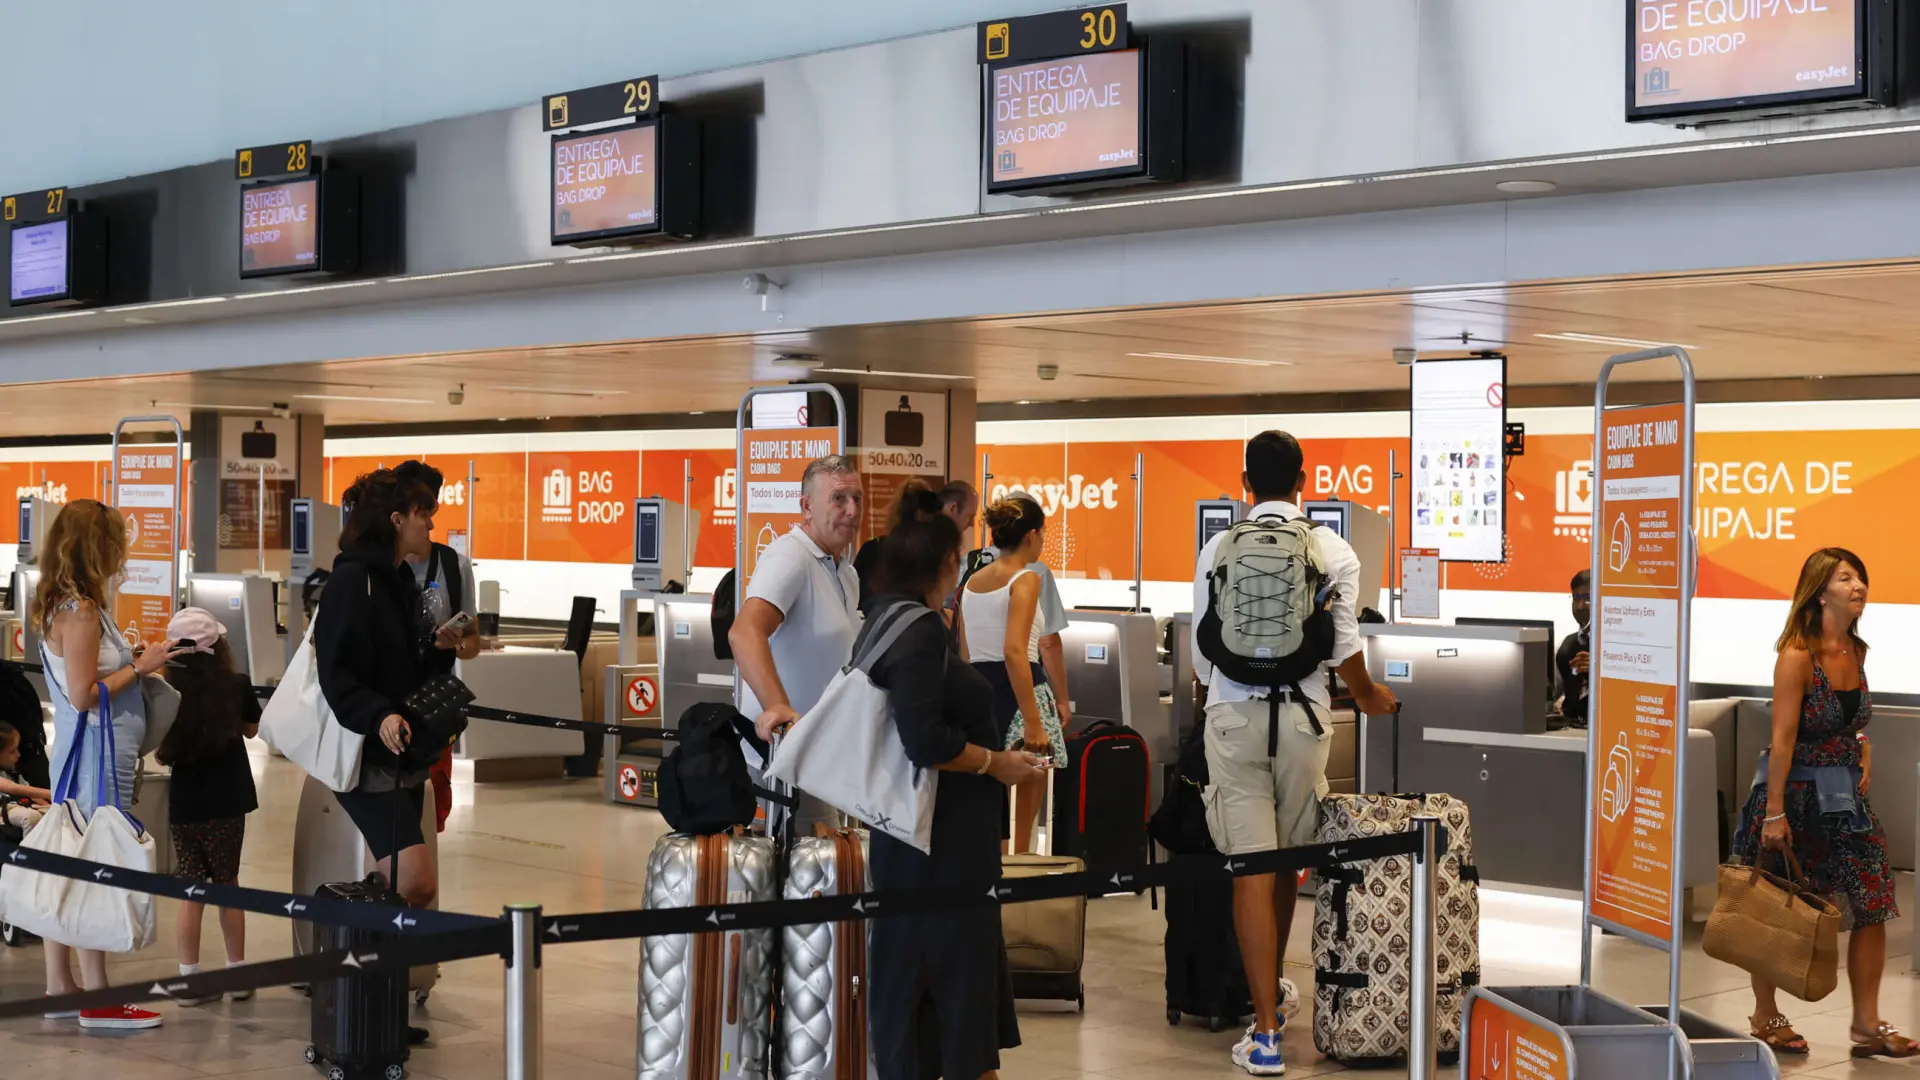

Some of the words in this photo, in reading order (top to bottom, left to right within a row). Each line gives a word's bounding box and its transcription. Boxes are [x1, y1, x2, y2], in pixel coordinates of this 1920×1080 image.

[1080, 9, 1116, 48] 30
[1641, 4, 1678, 32] DE
[1640, 40, 1682, 62] BAG
[1688, 32, 1746, 57] DROP
[996, 64, 1088, 98] ENTREGA
[1796, 65, 1848, 82] easyJet
[624, 80, 650, 114] 29
[997, 98, 1022, 122] DE
[1028, 83, 1120, 118] EQUIPAJE
[996, 127, 1024, 146] BAG
[1028, 122, 1066, 141] DROP
[287, 144, 306, 172] 28
[557, 138, 620, 165] ENTREGA
[1098, 148, 1134, 162] easyJet
[557, 166, 574, 185] DE
[578, 154, 644, 182] EQUIPAJE
[47, 189, 64, 214] 27
[244, 189, 292, 212] ENTREGA
[556, 190, 576, 205] BAG
[578, 186, 606, 202] DROP
[244, 211, 258, 228] DE
[1608, 424, 1640, 450] EQUIPAJE
[1643, 422, 1654, 446] DE
[1655, 420, 1678, 446] MANO
[750, 440, 788, 460] EQUIPAJE
[792, 440, 802, 459] DE
[805, 440, 830, 459] MANO
[578, 470, 612, 494] BAG
[1316, 464, 1372, 494] BAG
[1694, 461, 1794, 494] REGA
[1806, 461, 1853, 494] DE
[751, 488, 772, 498] Todos
[774, 488, 784, 498] los
[578, 501, 624, 524] DROP
[1694, 507, 1796, 540] IPAJE
